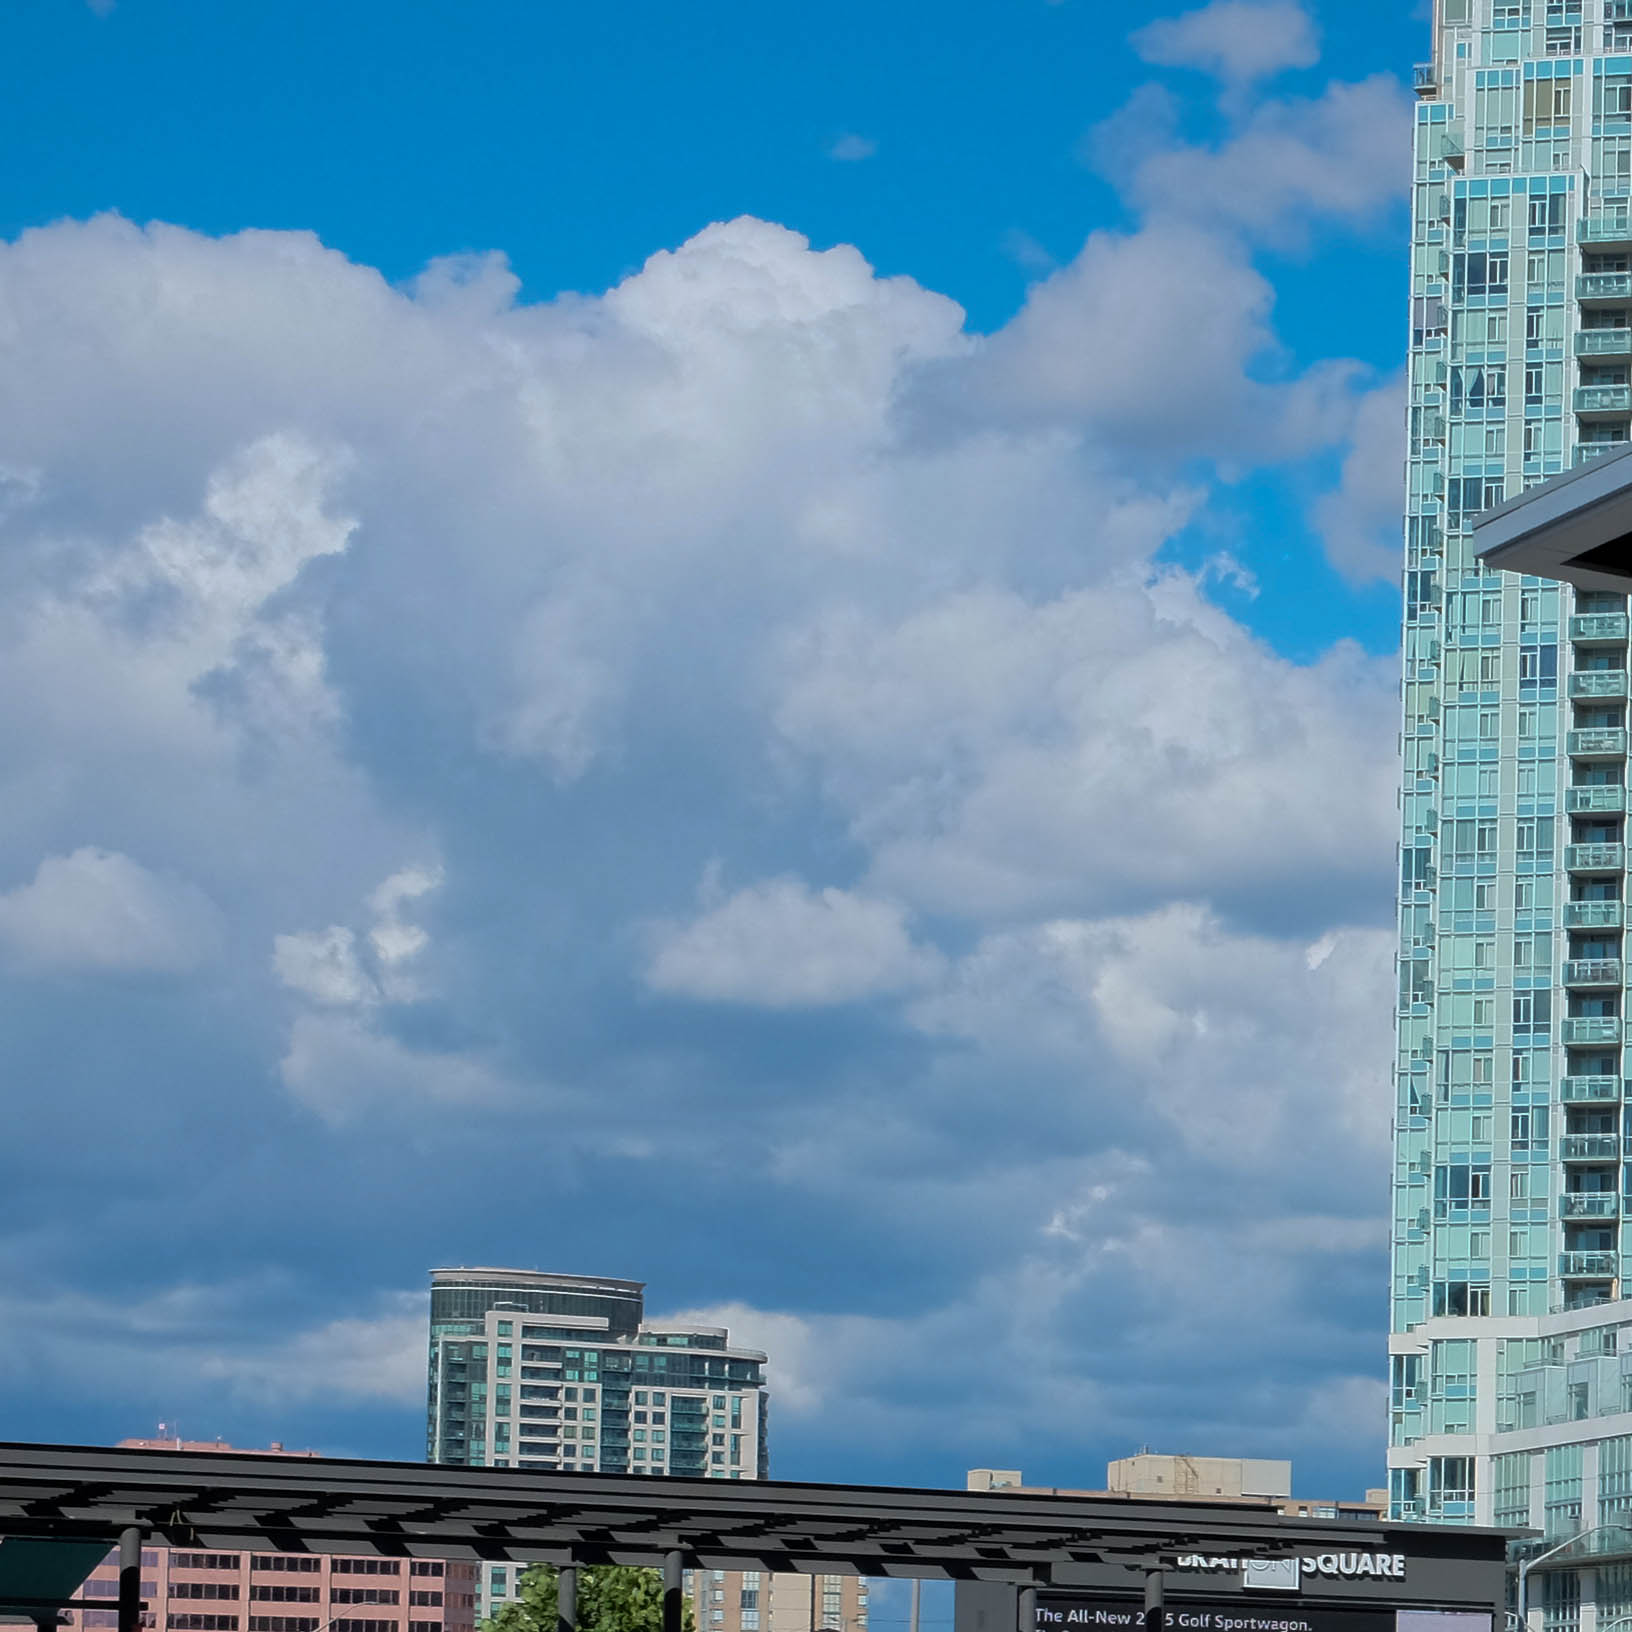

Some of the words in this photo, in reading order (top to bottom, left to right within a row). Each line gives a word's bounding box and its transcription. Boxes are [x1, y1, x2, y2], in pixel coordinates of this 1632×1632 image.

[1035, 1608, 1063, 1623] The
[1067, 1609, 1131, 1625] All-New
[1136, 1611, 1175, 1626] 25
[1179, 1613, 1212, 1628] Golf
